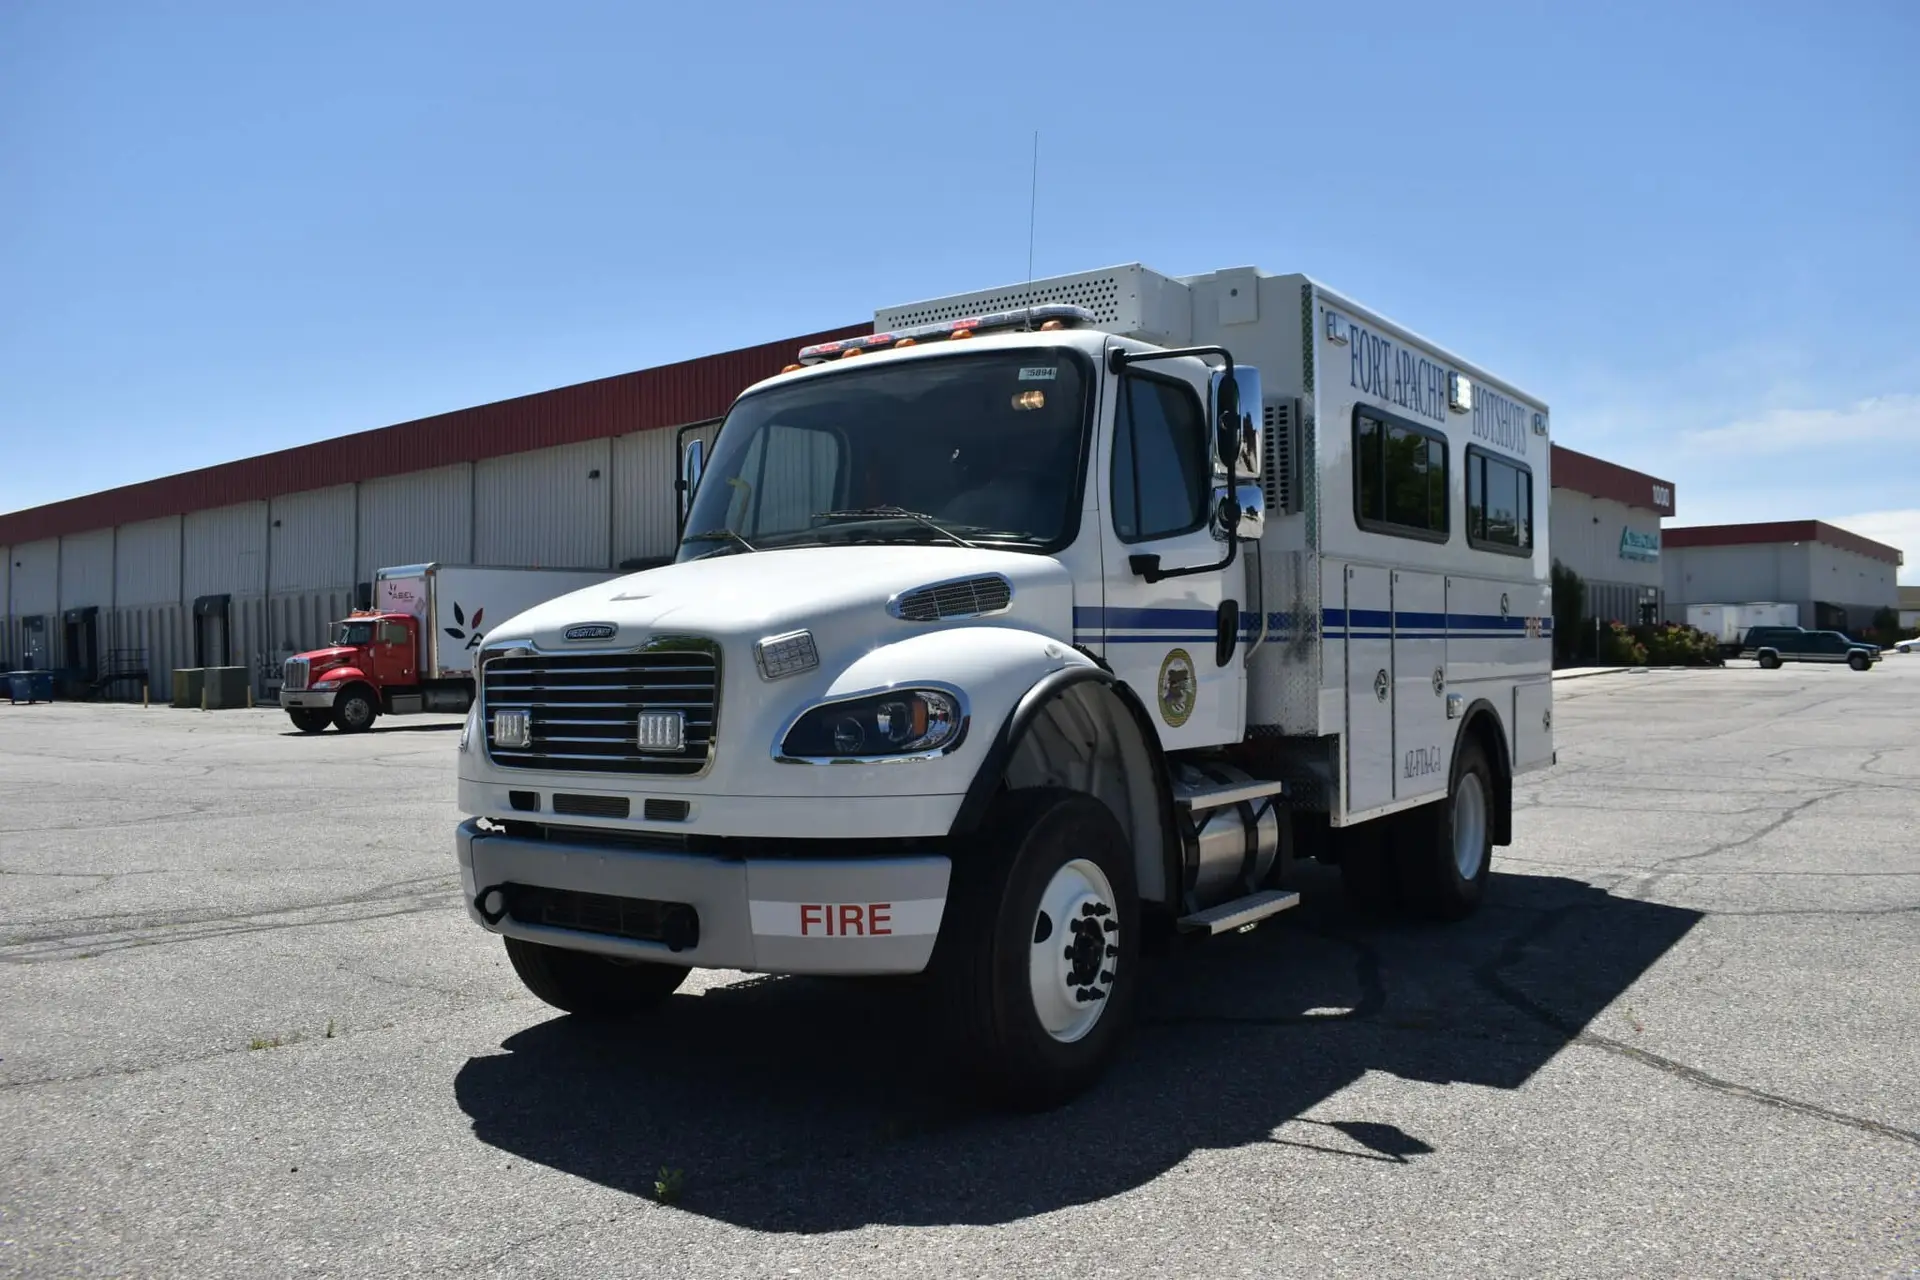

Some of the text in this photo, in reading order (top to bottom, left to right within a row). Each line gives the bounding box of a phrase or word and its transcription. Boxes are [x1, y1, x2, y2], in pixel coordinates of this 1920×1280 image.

[1349, 324, 1526, 456] FORT APACHE HOTSHOTS
[800, 903, 893, 937] FIRE
